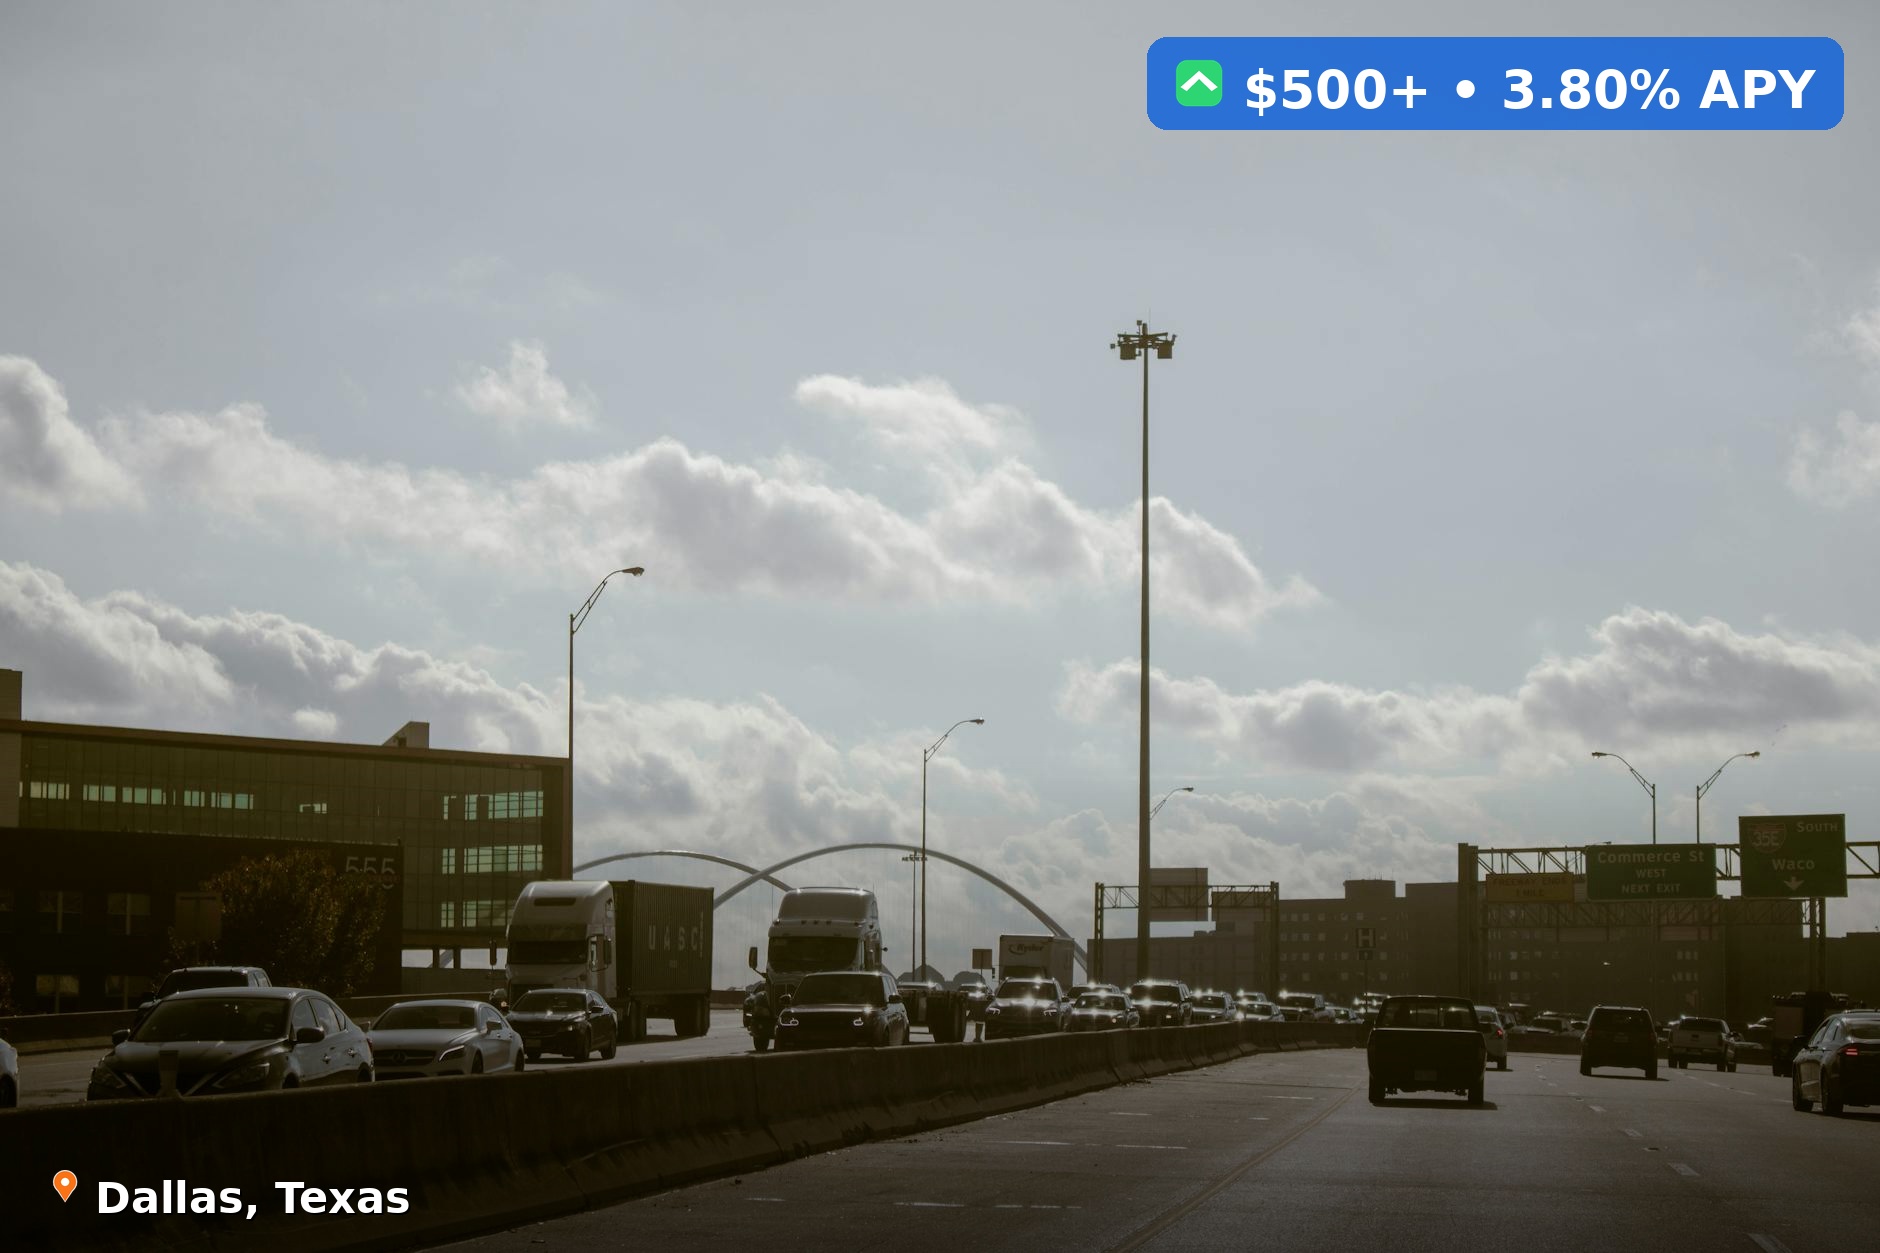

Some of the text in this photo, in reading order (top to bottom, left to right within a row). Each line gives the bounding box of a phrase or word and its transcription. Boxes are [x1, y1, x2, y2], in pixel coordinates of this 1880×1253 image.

[1752, 831, 1780, 847] 35E
[1598, 850, 1705, 864] Commerce St
[1772, 858, 1815, 871] Waco
[1635, 868, 1667, 879] WEST
[1621, 883, 1681, 894] NEXT EXIT
[648, 924, 698, 952] UASC
[1358, 929, 1373, 947] H
